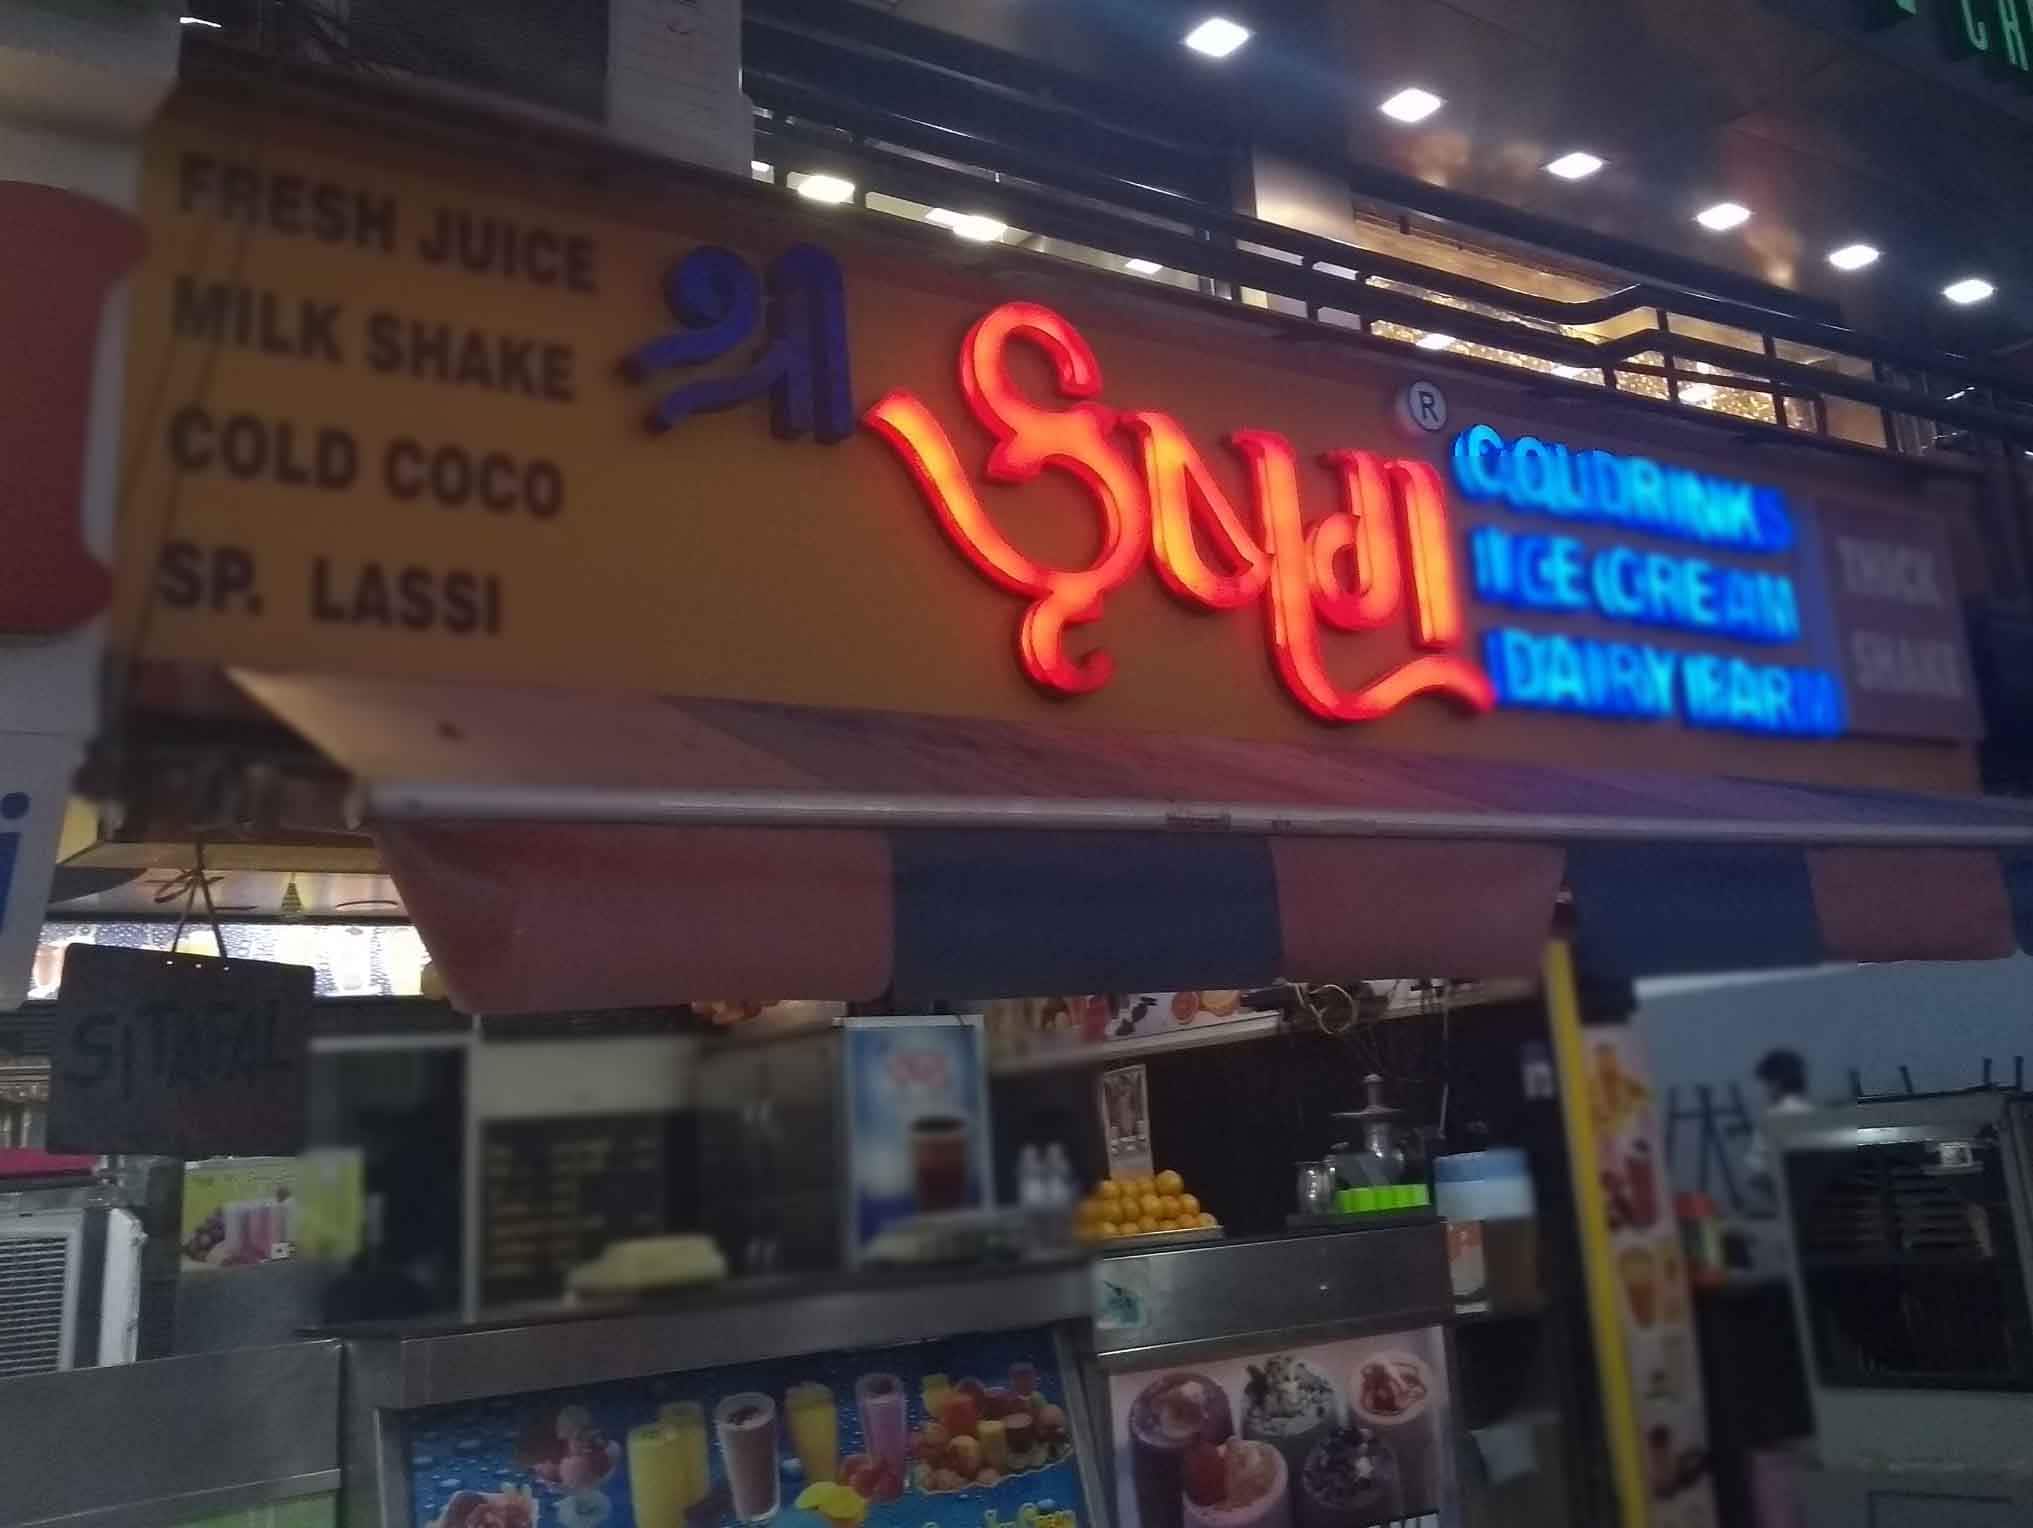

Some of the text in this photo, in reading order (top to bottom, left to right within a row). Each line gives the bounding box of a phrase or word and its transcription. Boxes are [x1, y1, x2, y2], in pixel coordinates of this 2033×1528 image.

[178, 152, 597, 293] FRESH JUICE
[172, 274, 577, 404] MILK SHAKE
[168, 403, 565, 520] COLD COCO
[158, 541, 506, 637] SP. LASSI
[1469, 525, 1804, 645] ICE CREAM
[1484, 625, 1676, 718] DAIRY
